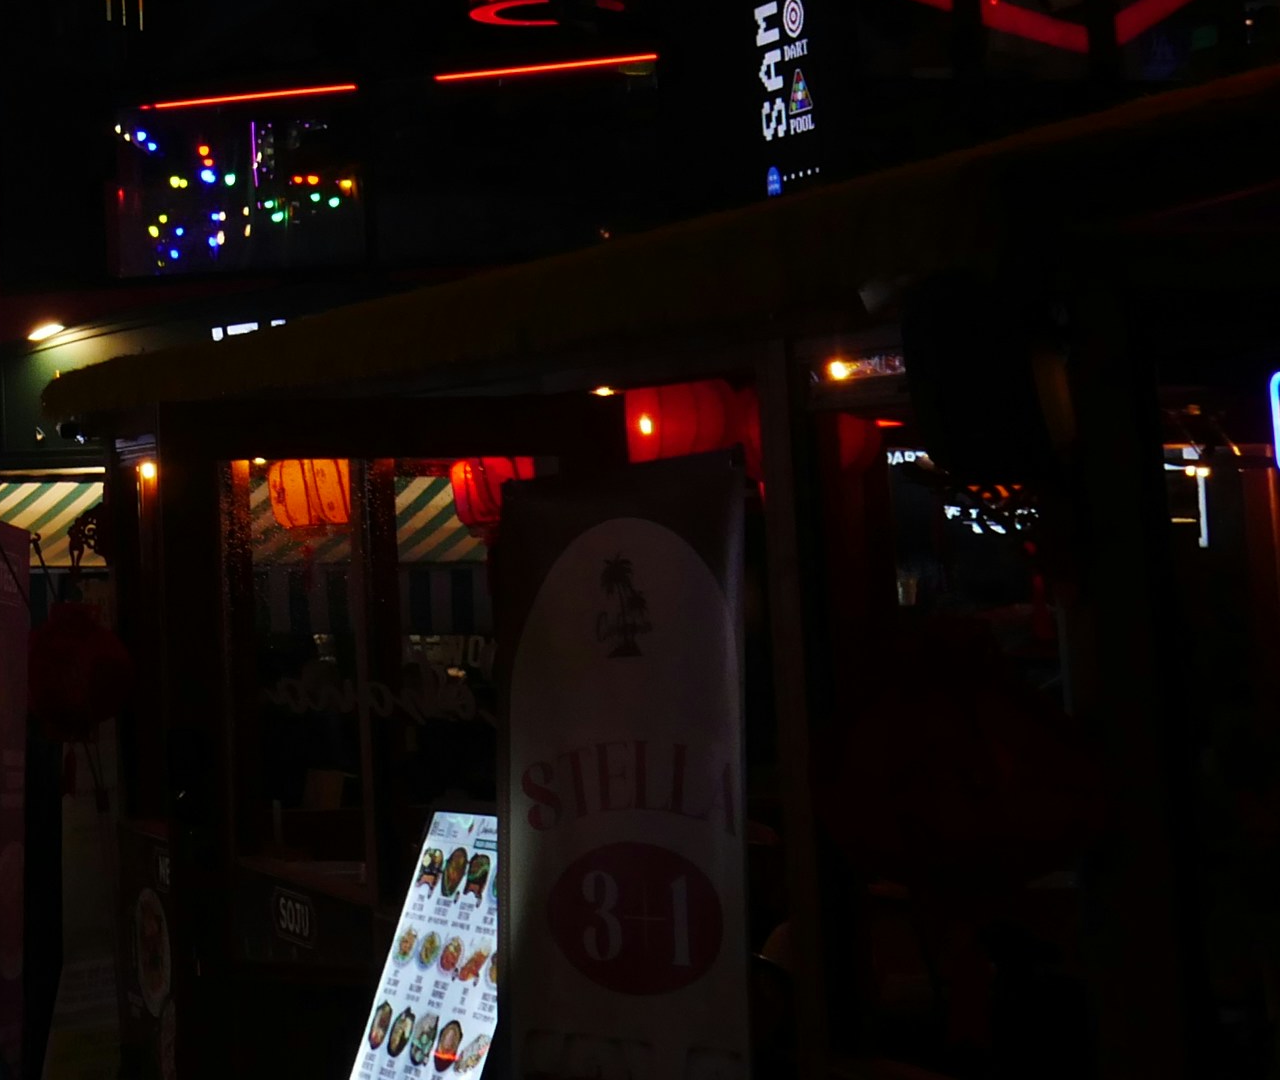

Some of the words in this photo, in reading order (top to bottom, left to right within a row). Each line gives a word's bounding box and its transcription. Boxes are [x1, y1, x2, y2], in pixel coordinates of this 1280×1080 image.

[753, 0, 787, 142] SAM
[783, 38, 809, 63] DART
[790, 113, 815, 136] POOL
[521, 740, 737, 836] STELLA
[279, 896, 310, 937] SOJU
[581, 869, 692, 968] 3+1
